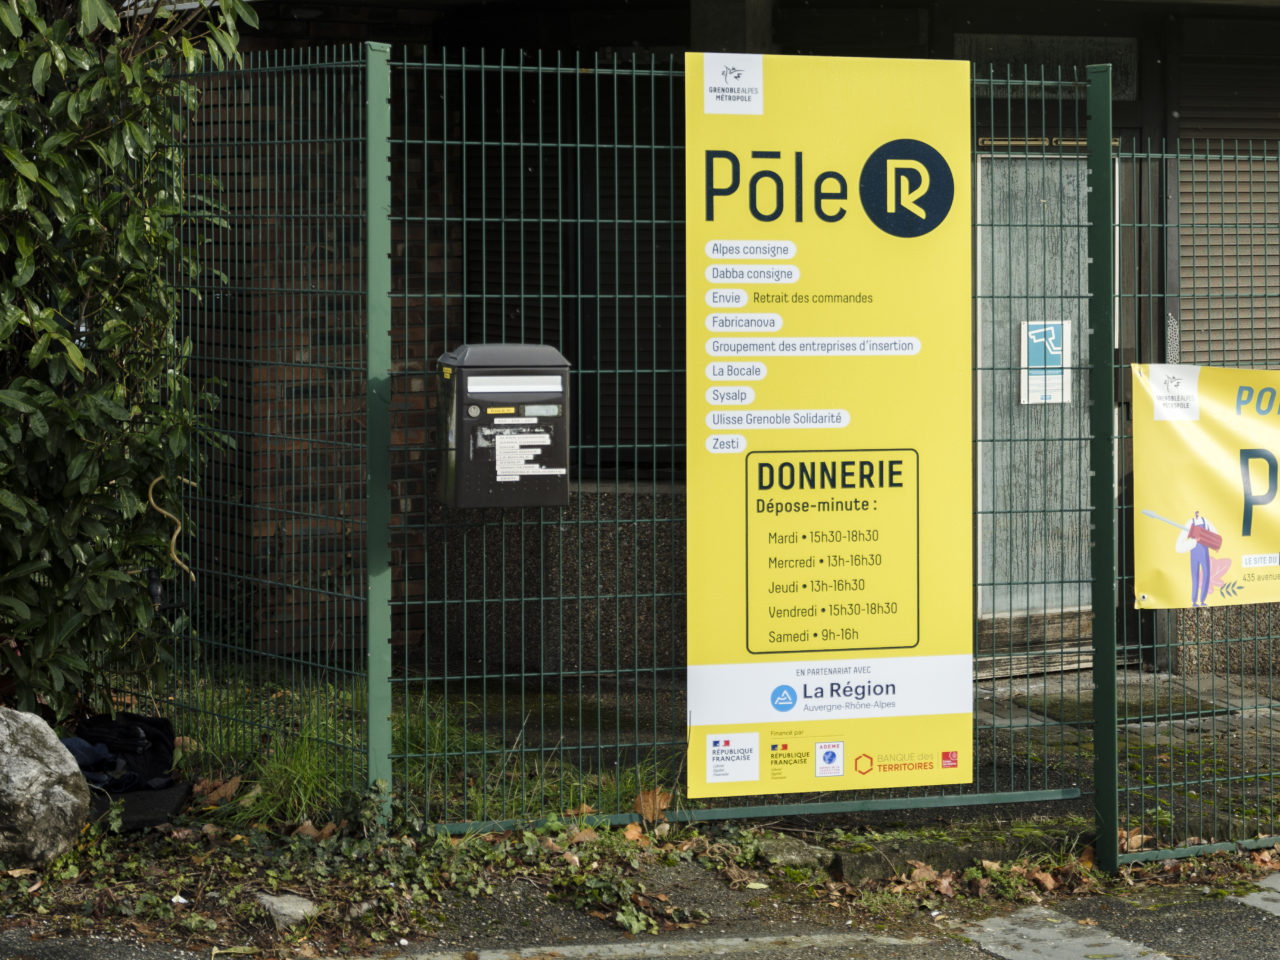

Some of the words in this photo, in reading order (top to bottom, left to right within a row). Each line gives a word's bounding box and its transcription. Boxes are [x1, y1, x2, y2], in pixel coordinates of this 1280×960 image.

[716, 94, 752, 102] MÉTROPOLE
[712, 244, 740, 257] Alpes
[743, 245, 789, 258] consigne
[712, 268, 744, 279] Dabba
[747, 269, 793, 281] consigne
[712, 292, 741, 304] Envie
[753, 292, 789, 304] Retrait
[791, 292, 810, 304] des
[812, 292, 873, 304] commandes
[712, 317, 776, 328] Fabricanova
[712, 341, 776, 354] Groupement
[779, 341, 797, 352] des
[799, 340, 857, 354] entreprises
[712, 365, 724, 376] La
[727, 365, 761, 376] Bocale
[712, 389, 747, 403] Sysalp
[712, 414, 743, 425] Ulisse
[745, 413, 791, 425] Grenoble
[793, 412, 842, 424] Solidarité
[712, 438, 739, 450] Zesti
[758, 460, 903, 490] DONNERIE
[756, 498, 869, 516] Dépose-minute
[768, 531, 799, 544] Mardi
[810, 530, 879, 543] 15h30-18h30
[768, 556, 815, 569] Mercredi
[827, 554, 882, 567] 13h-16h30
[1254, 557, 1267, 565] SITE
[1269, 556, 1277, 564] DU
[1242, 574, 1255, 582] 435
[768, 581, 799, 594] Jeudi
[810, 579, 865, 592] 13h-16h30
[768, 606, 817, 618] Vendredi
[828, 602, 898, 616] 15h30-18h30
[768, 630, 809, 643] Samedi
[821, 628, 859, 641] 9h-16h
[796, 668, 806, 677] EN
[807, 667, 851, 676] PARTENARIAT
[853, 666, 871, 674] AVEC
[803, 683, 824, 699] La
[830, 680, 896, 700] Région
[803, 700, 896, 713] Auvergne-Rhône-Alpes
[712, 748, 753, 756] RÉPUBLIQUE
[877, 753, 915, 762] BANQUE
[712, 755, 751, 763] FRANÇAISE
[877, 762, 934, 772] TERRITOIRES
